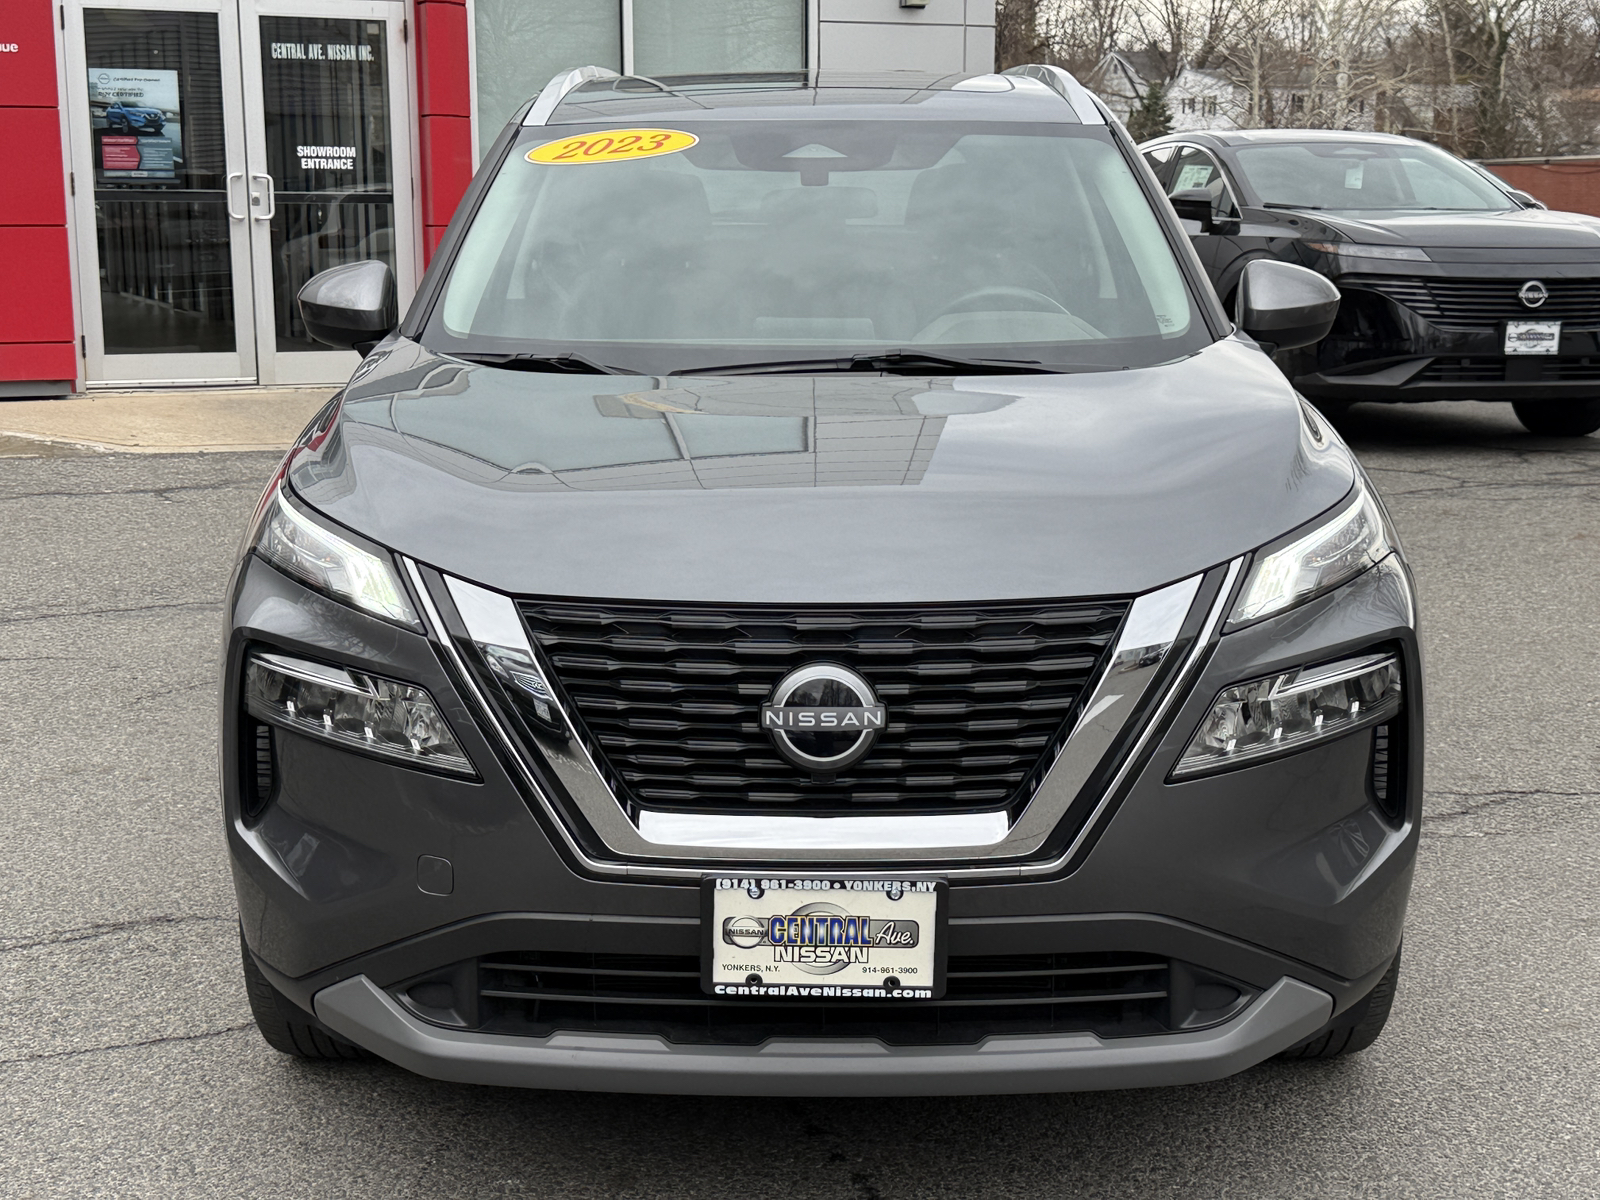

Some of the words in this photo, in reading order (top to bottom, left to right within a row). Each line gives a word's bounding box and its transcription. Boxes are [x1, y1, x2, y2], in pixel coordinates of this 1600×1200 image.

[271, 43, 306, 59] CENTRAL
[308, 44, 326, 60] AVE.
[327, 44, 357, 60] NISSAN
[358, 45, 375, 61] INC.
[296, 146, 356, 157] SHOWROOM
[552, 134, 672, 160] 2023
[301, 158, 354, 169] ENTRANCE
[766, 711, 881, 726] NISSAN
[760, 879, 831, 891] 961-3900
[728, 928, 765, 936] NISSAN
[768, 915, 874, 947] CENTRAL
[875, 921, 914, 945] Ave.
[774, 946, 870, 963] NISSAN
[722, 964, 764, 973] YONKERS,
[765, 965, 781, 973] N.Y.
[862, 966, 918, 974] 914-961-3900
[714, 985, 932, 998] CentralAveNissan.com
